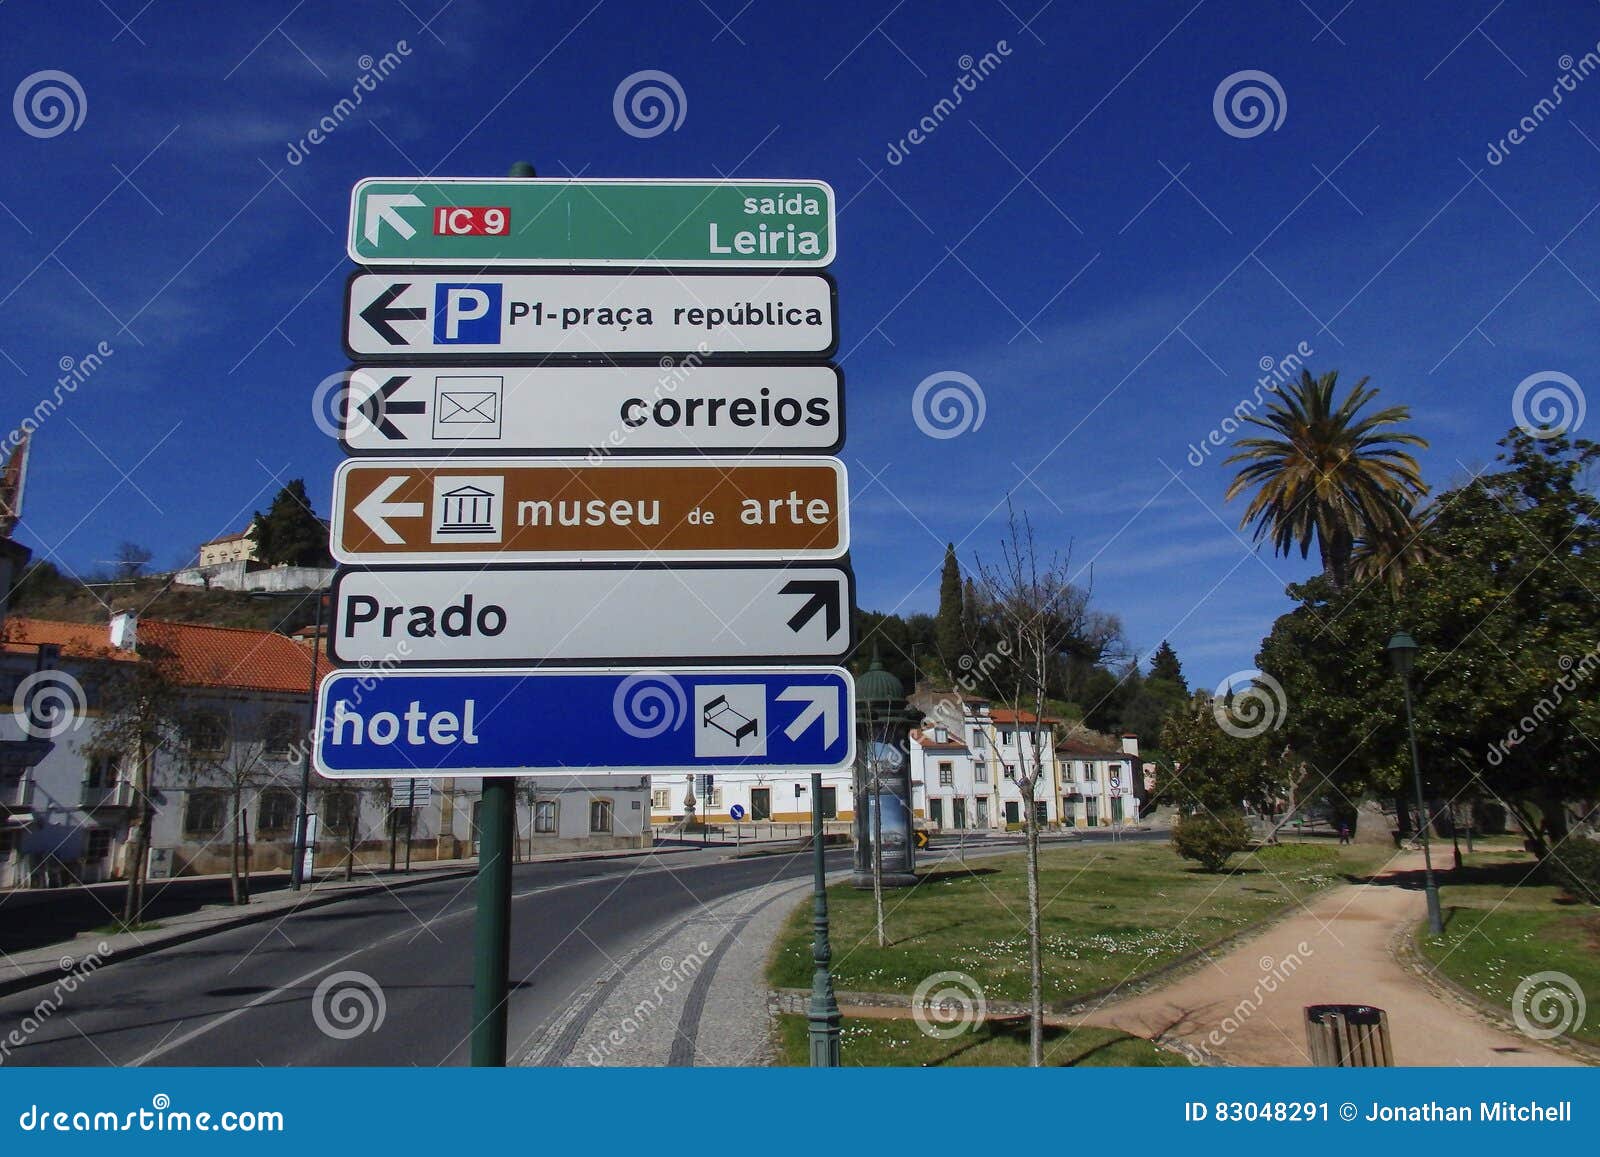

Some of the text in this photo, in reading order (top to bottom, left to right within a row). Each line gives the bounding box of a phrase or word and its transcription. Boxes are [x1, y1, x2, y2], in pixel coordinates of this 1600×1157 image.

[439, 208, 505, 235] IC 9
[743, 192, 820, 216] saída
[709, 222, 821, 256] Leiria
[445, 288, 823, 339] P P1-praça república
[620, 387, 831, 428] correios
[517, 490, 830, 527] museu de arte
[344, 593, 507, 638] Prado
[331, 699, 479, 746] hotel
